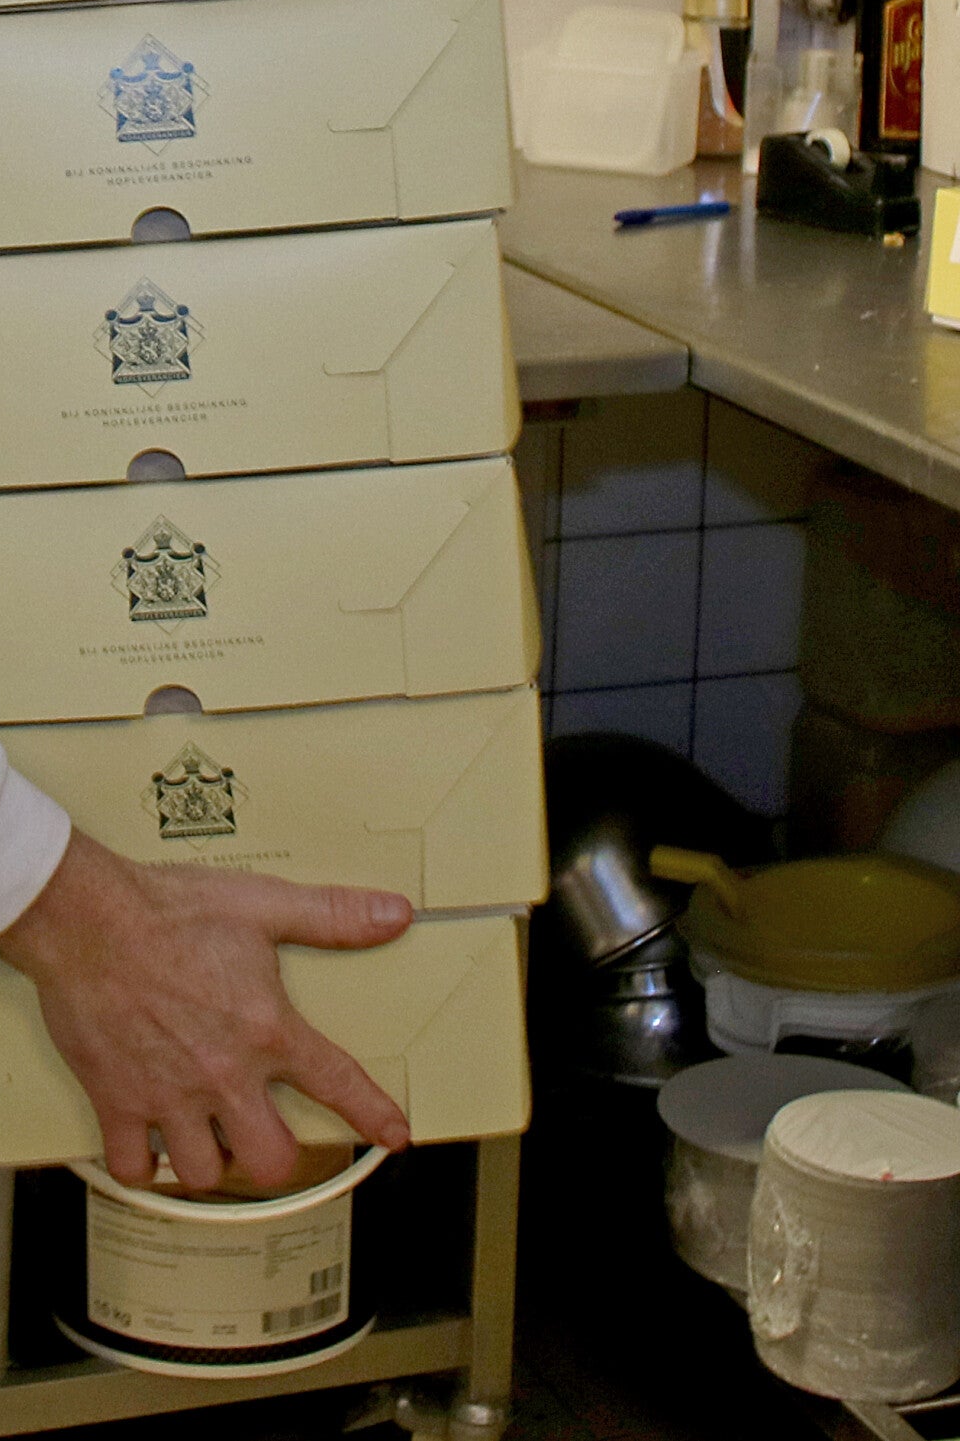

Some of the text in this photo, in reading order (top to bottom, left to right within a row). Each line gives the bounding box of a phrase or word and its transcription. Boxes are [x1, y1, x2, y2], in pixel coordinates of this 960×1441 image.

[107, 171, 213, 185] HOFLEVERANCIER
[102, 413, 207, 427] HOFLEVERANCIER
[120, 649, 224, 664] HOFLEVERANCIER
